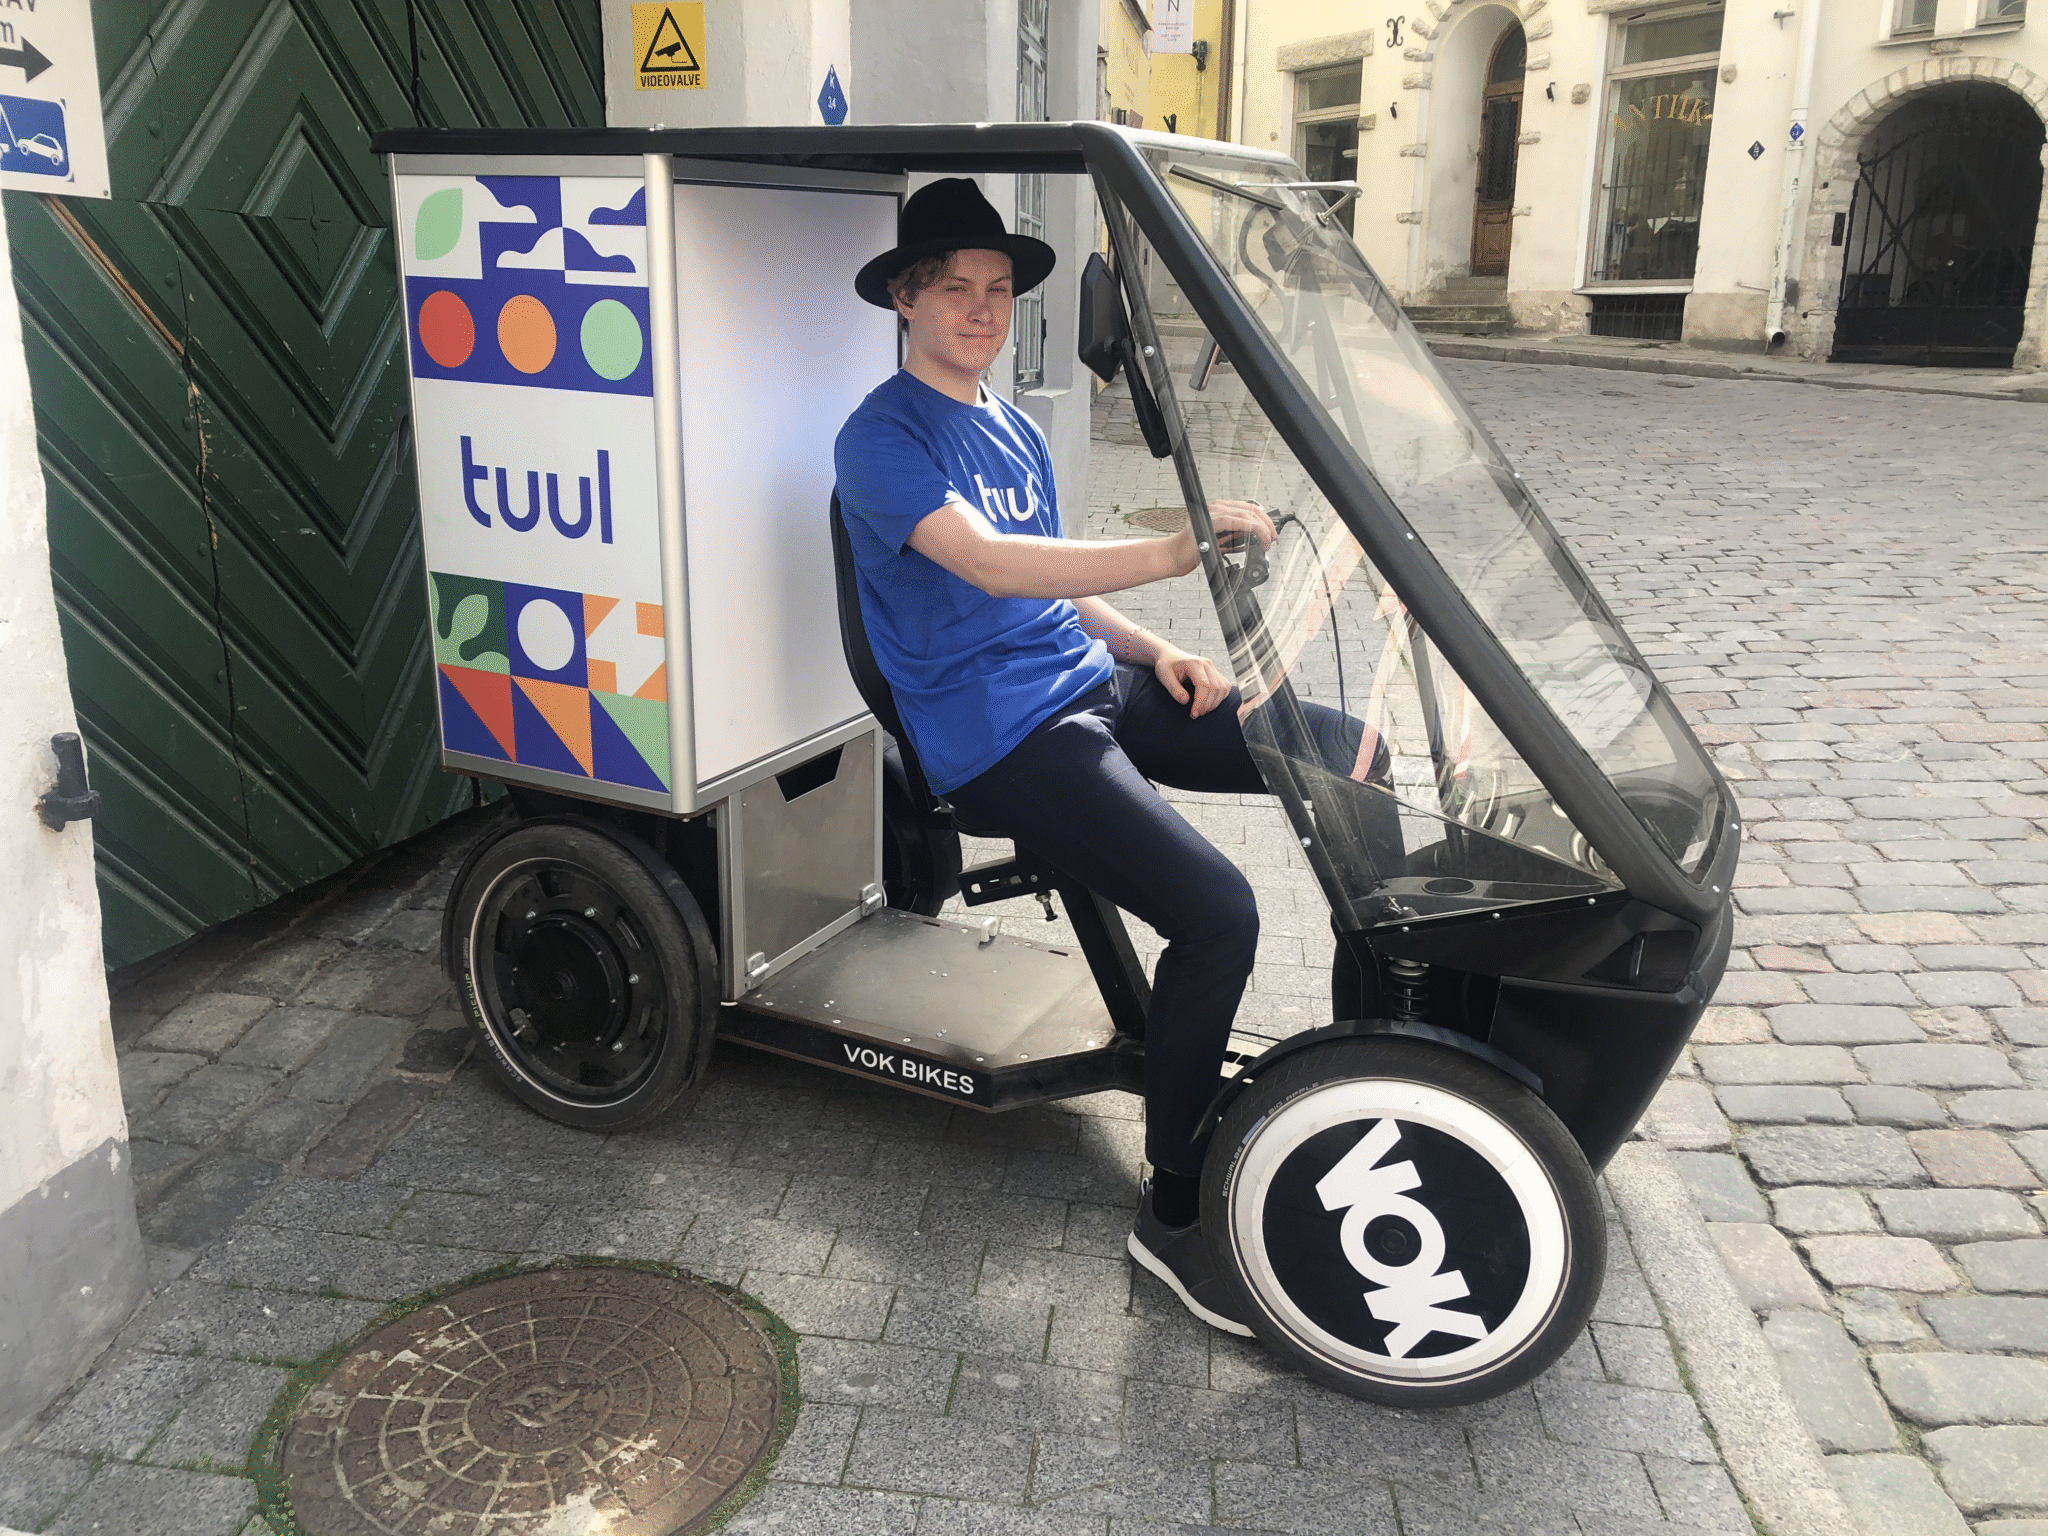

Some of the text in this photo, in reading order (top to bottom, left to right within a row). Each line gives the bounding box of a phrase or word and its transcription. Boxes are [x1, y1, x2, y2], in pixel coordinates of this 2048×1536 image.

[640, 73, 701, 88] VIDEOVALVE
[460, 435, 613, 544] tuul
[464, 973, 524, 1084] SCHWALBE PICK-UP
[843, 1043, 975, 1095] VOK BIKES
[1222, 1082, 1319, 1197] SCHWALBE BIG APPLE
[1315, 1118, 1489, 1358] VOK
